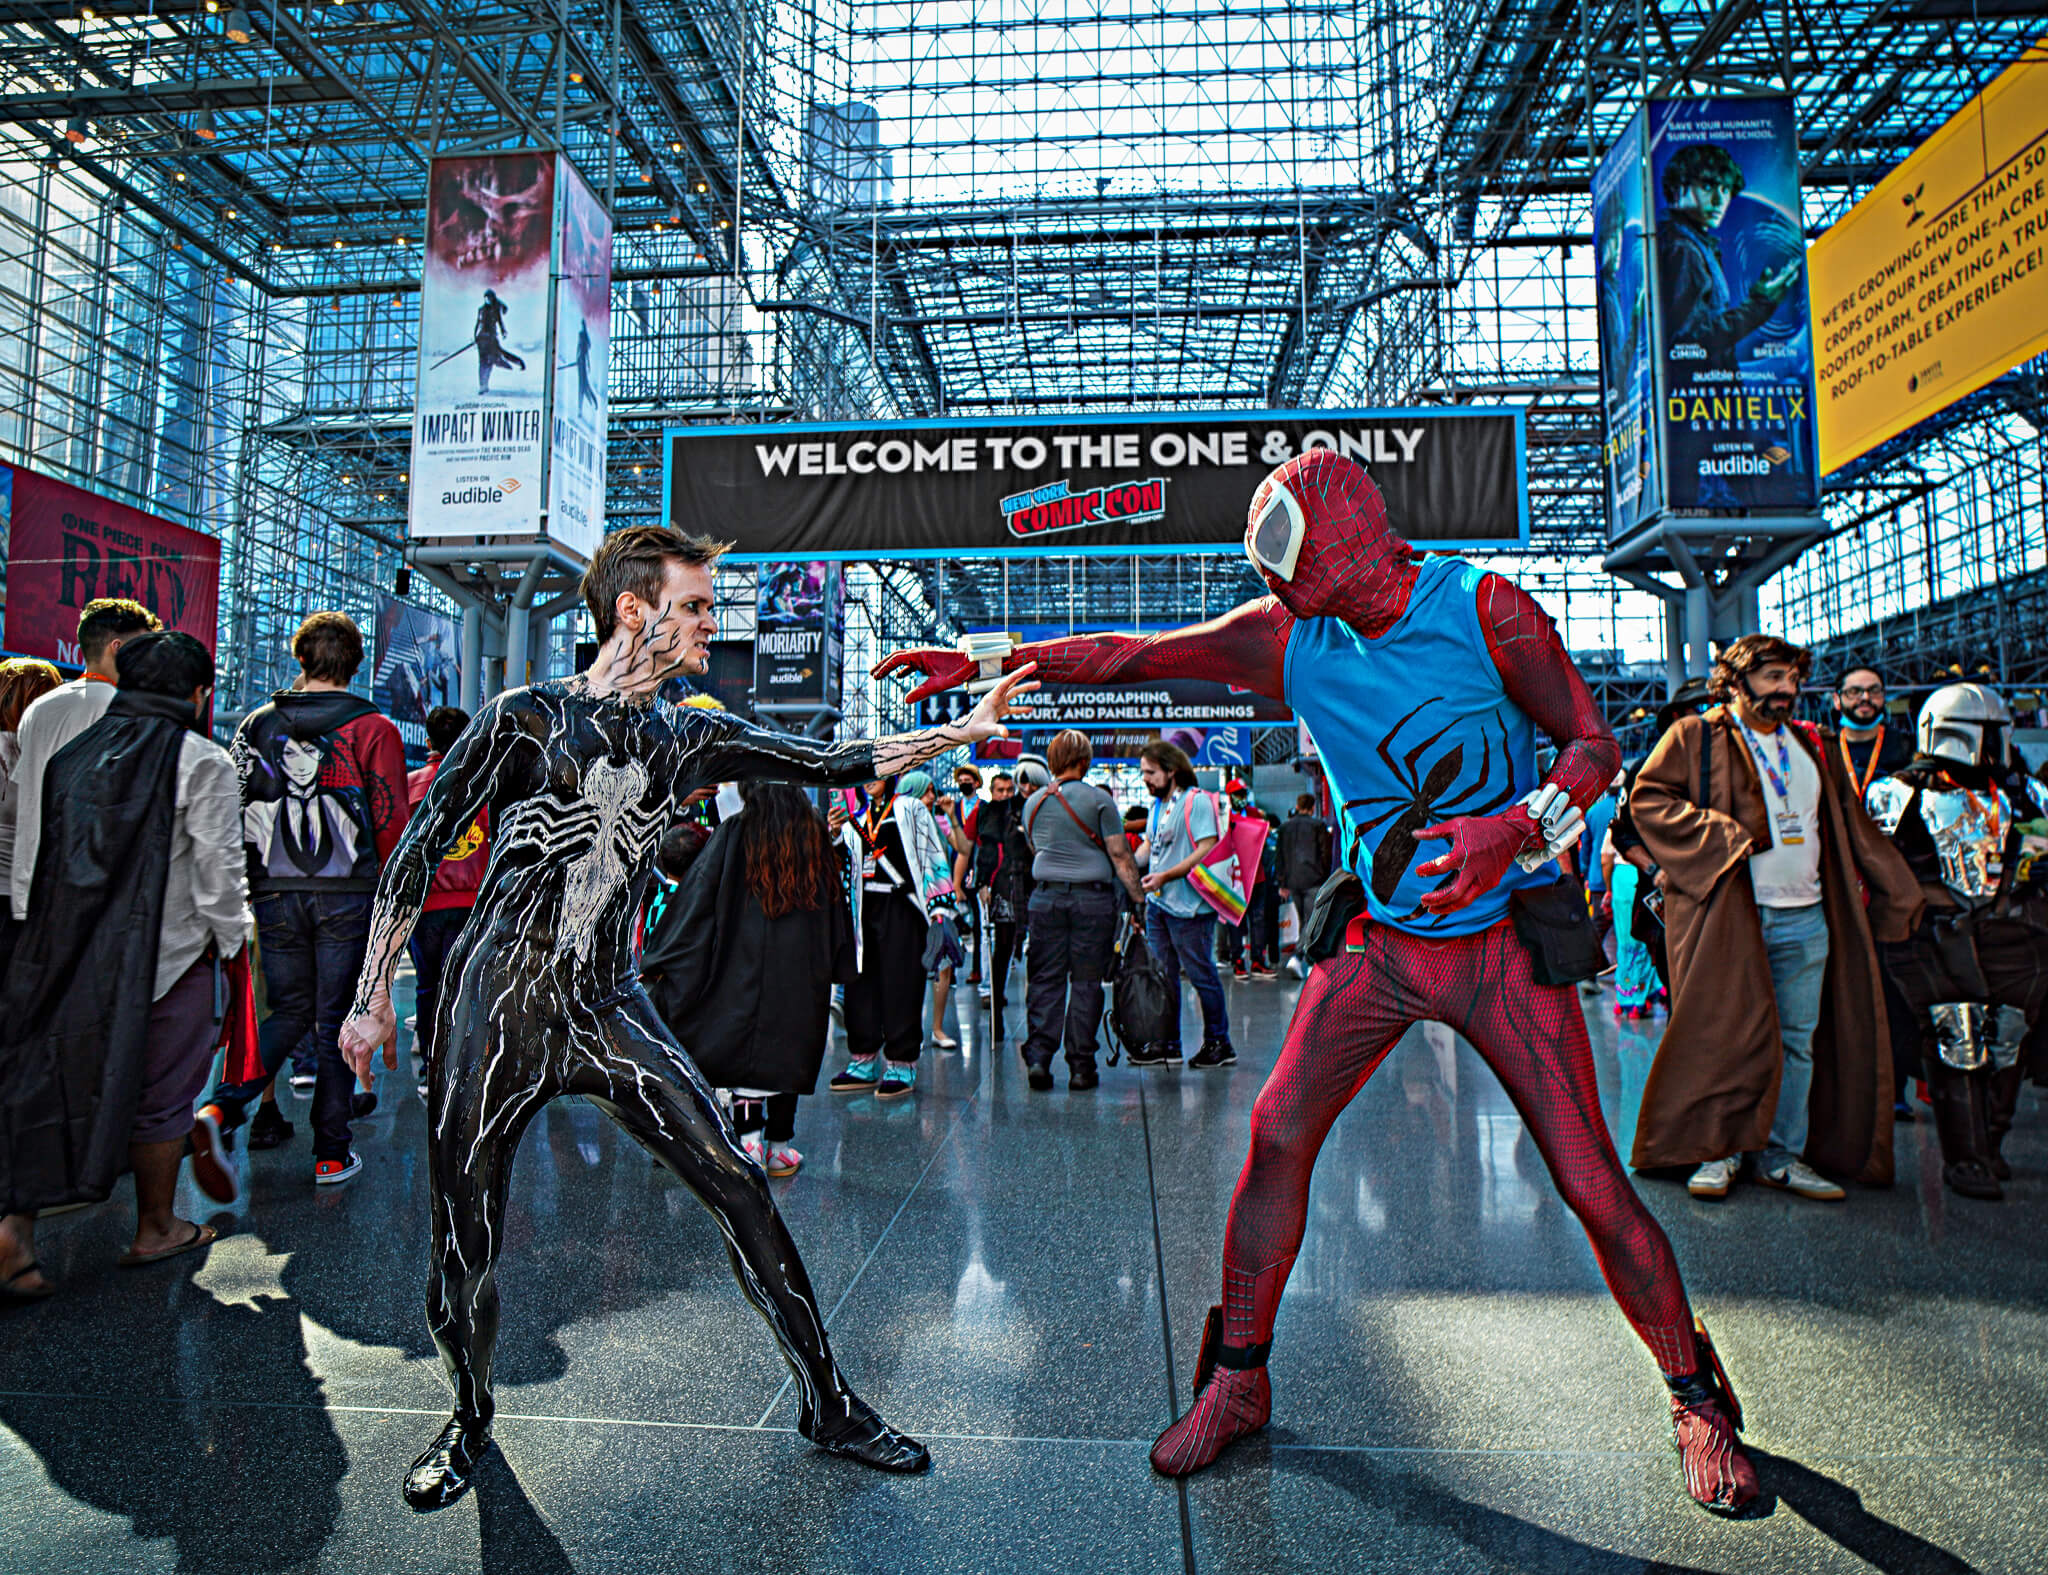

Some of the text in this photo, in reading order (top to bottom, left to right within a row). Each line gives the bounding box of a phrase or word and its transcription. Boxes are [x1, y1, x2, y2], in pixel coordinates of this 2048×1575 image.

[1667, 131, 1707, 141] SURVIVE
[1709, 130, 1733, 139] HIGH
[1668, 121, 1692, 131] SAVE
[1695, 120, 1721, 130] YOUR
[1821, 145, 2046, 328] WE'RE GROWING MORE THAN 50
[1824, 178, 2046, 353] CROPS ON OUR NEW ONE-ACRE
[1819, 332, 1874, 382] ROOFTOP
[1917, 247, 1994, 314] CREATING
[1997, 239, 2010, 261] A
[1831, 246, 2045, 401] ROOF-TO-TABLE EXPERIENCE!
[1671, 385, 1803, 398] JAMES PATTERSON
[1668, 396, 1783, 421] DANIEL
[1788, 396, 1807, 420] X
[421, 409, 541, 445] IMPACT WINTER
[1690, 419, 1787, 431] GENESIS
[755, 428, 1425, 477] WELCOME TO THE ONE & ONLY
[1712, 442, 1741, 452] LISTEN
[1698, 454, 1771, 476] audible
[455, 475, 479, 484] LISTEN
[441, 487, 503, 505] audible
[1002, 482, 1069, 514] NEW YORK
[1013, 481, 1163, 534] COMIC CON
[62, 512, 99, 538] ONE
[103, 525, 143, 552] PIECE
[758, 631, 822, 655] MORIARTY
[1057, 691, 1173, 706] AUTOGRAPHING,
[1065, 707, 1095, 720] AND
[1097, 706, 1150, 720] PANELS
[1152, 706, 1164, 719] &
[1165, 705, 1256, 719] SCREENINGS
